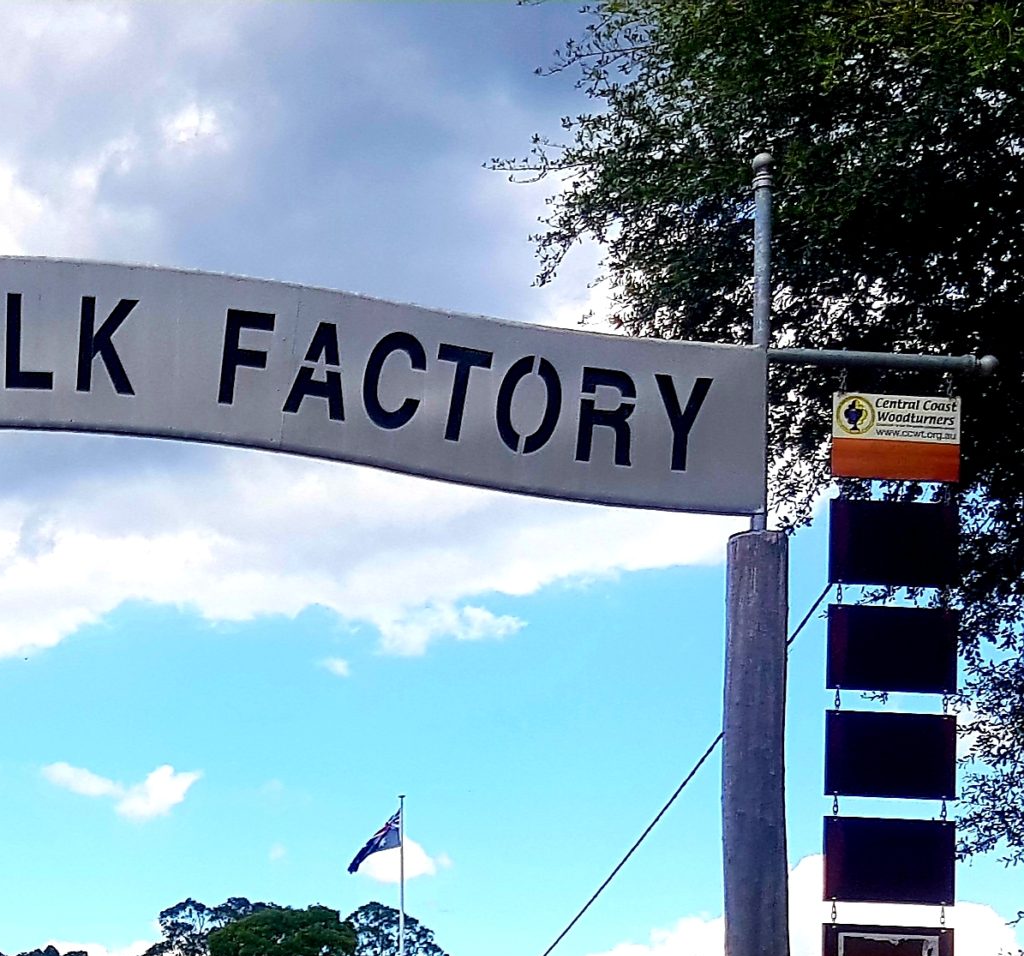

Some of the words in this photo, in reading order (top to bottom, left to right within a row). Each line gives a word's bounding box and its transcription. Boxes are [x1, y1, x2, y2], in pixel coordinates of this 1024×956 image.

[217, 308, 714, 472] FACTORY
[875, 397, 920, 410] Central
[923, 400, 958, 412] Coast
[877, 411, 955, 426] Woodturners
[876, 429, 956, 441] www.ccwt.org.au
